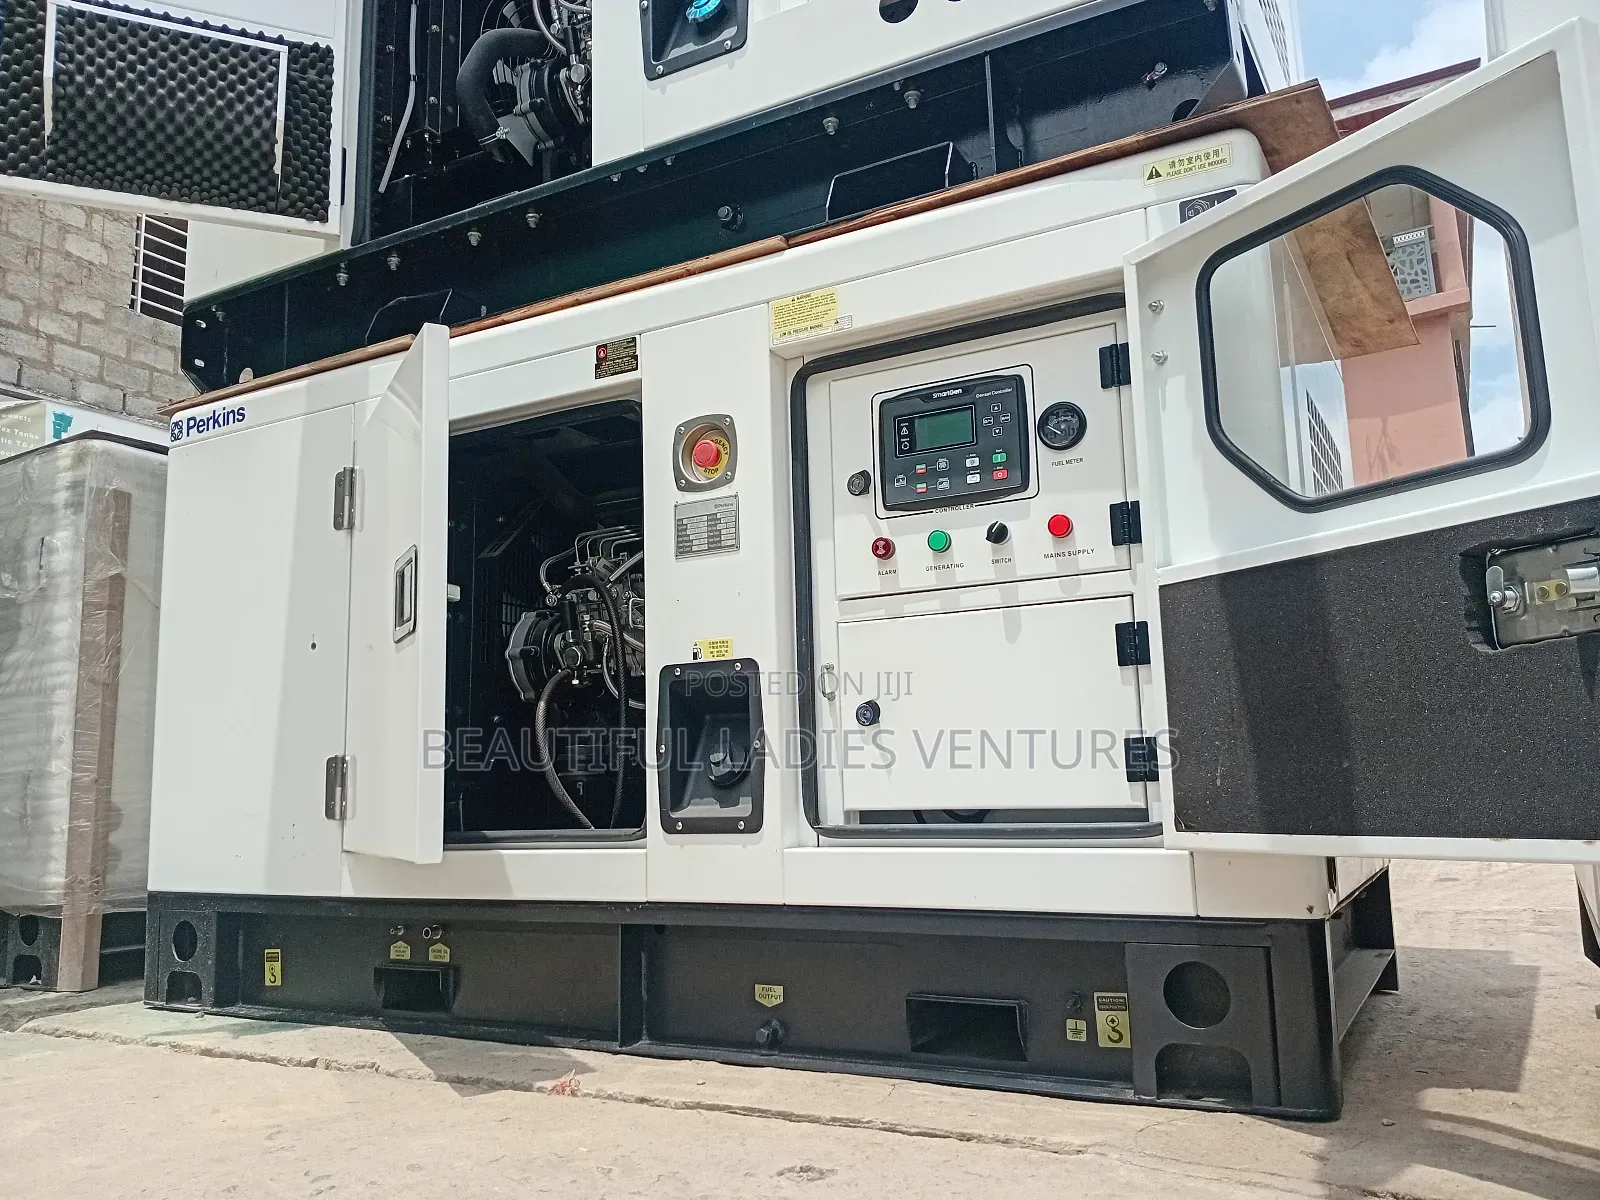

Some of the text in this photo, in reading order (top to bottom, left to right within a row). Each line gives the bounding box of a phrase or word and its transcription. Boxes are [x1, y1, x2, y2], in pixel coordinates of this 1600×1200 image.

[1166, 169, 1183, 178] PLEASE
[1183, 165, 1197, 174] DON'T
[1207, 157, 1228, 168] INDOORS
[932, 388, 963, 399] SmartGen
[186, 406, 246, 437] Perkins
[13, 428, 40, 440] Tanks
[1065, 457, 1084, 465] METER
[703, 467, 719, 475] STOP
[934, 503, 975, 514] CONTROLLER
[1043, 548, 1096, 560] MAINS SUPPLY
[991, 556, 1012, 565] SWITCH
[925, 562, 965, 572] GENERATING
[877, 568, 897, 577] ALARM
[758, 993, 782, 1001] OUTPUT
